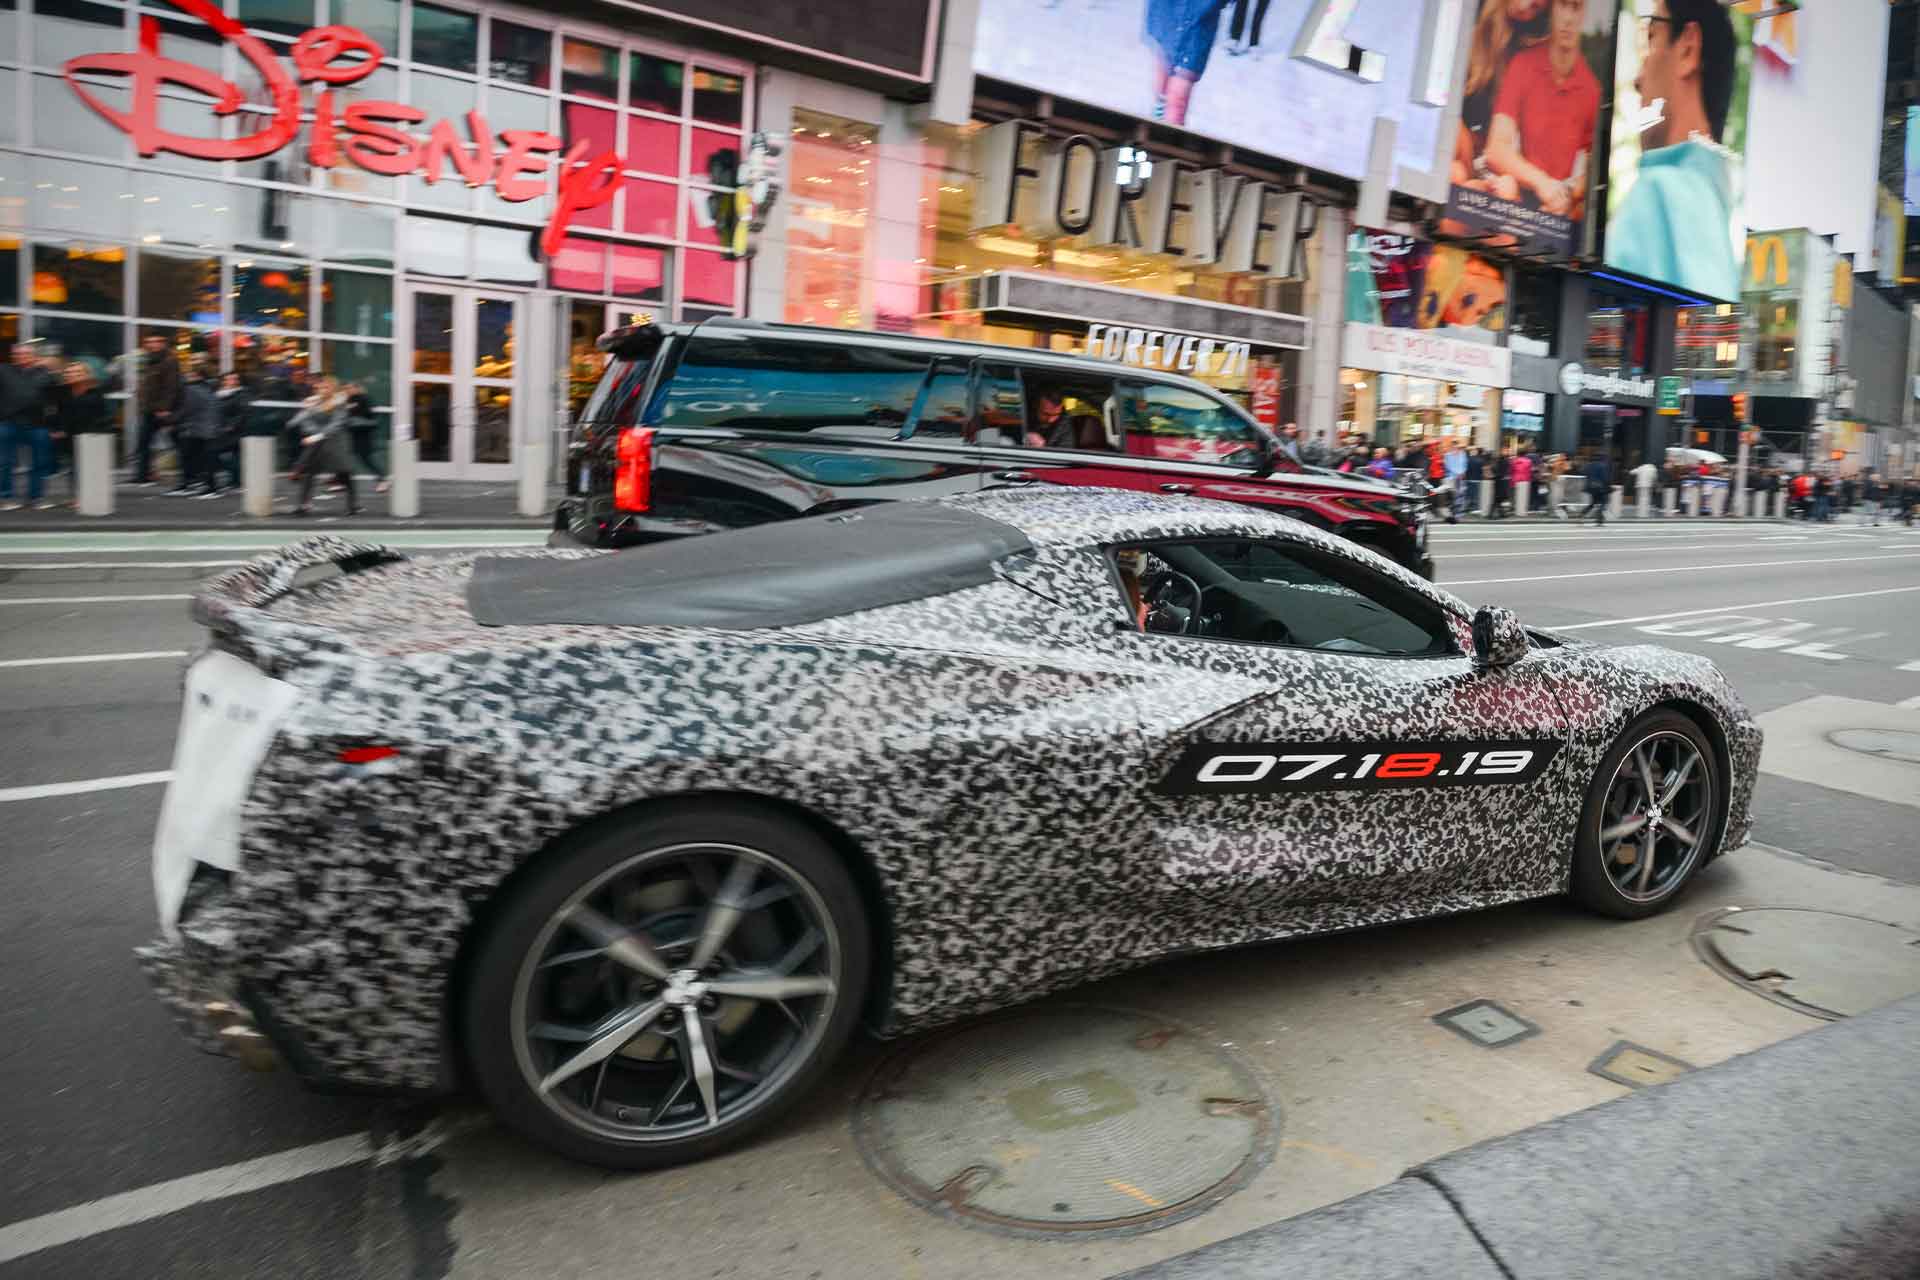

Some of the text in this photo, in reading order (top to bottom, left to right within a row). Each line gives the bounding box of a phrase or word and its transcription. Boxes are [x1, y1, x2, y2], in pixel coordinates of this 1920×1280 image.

[978, 119, 1318, 281] FOREVER
[1087, 322, 1252, 378] FOREVER 21
[1196, 750, 1535, 784] 07.18.19
